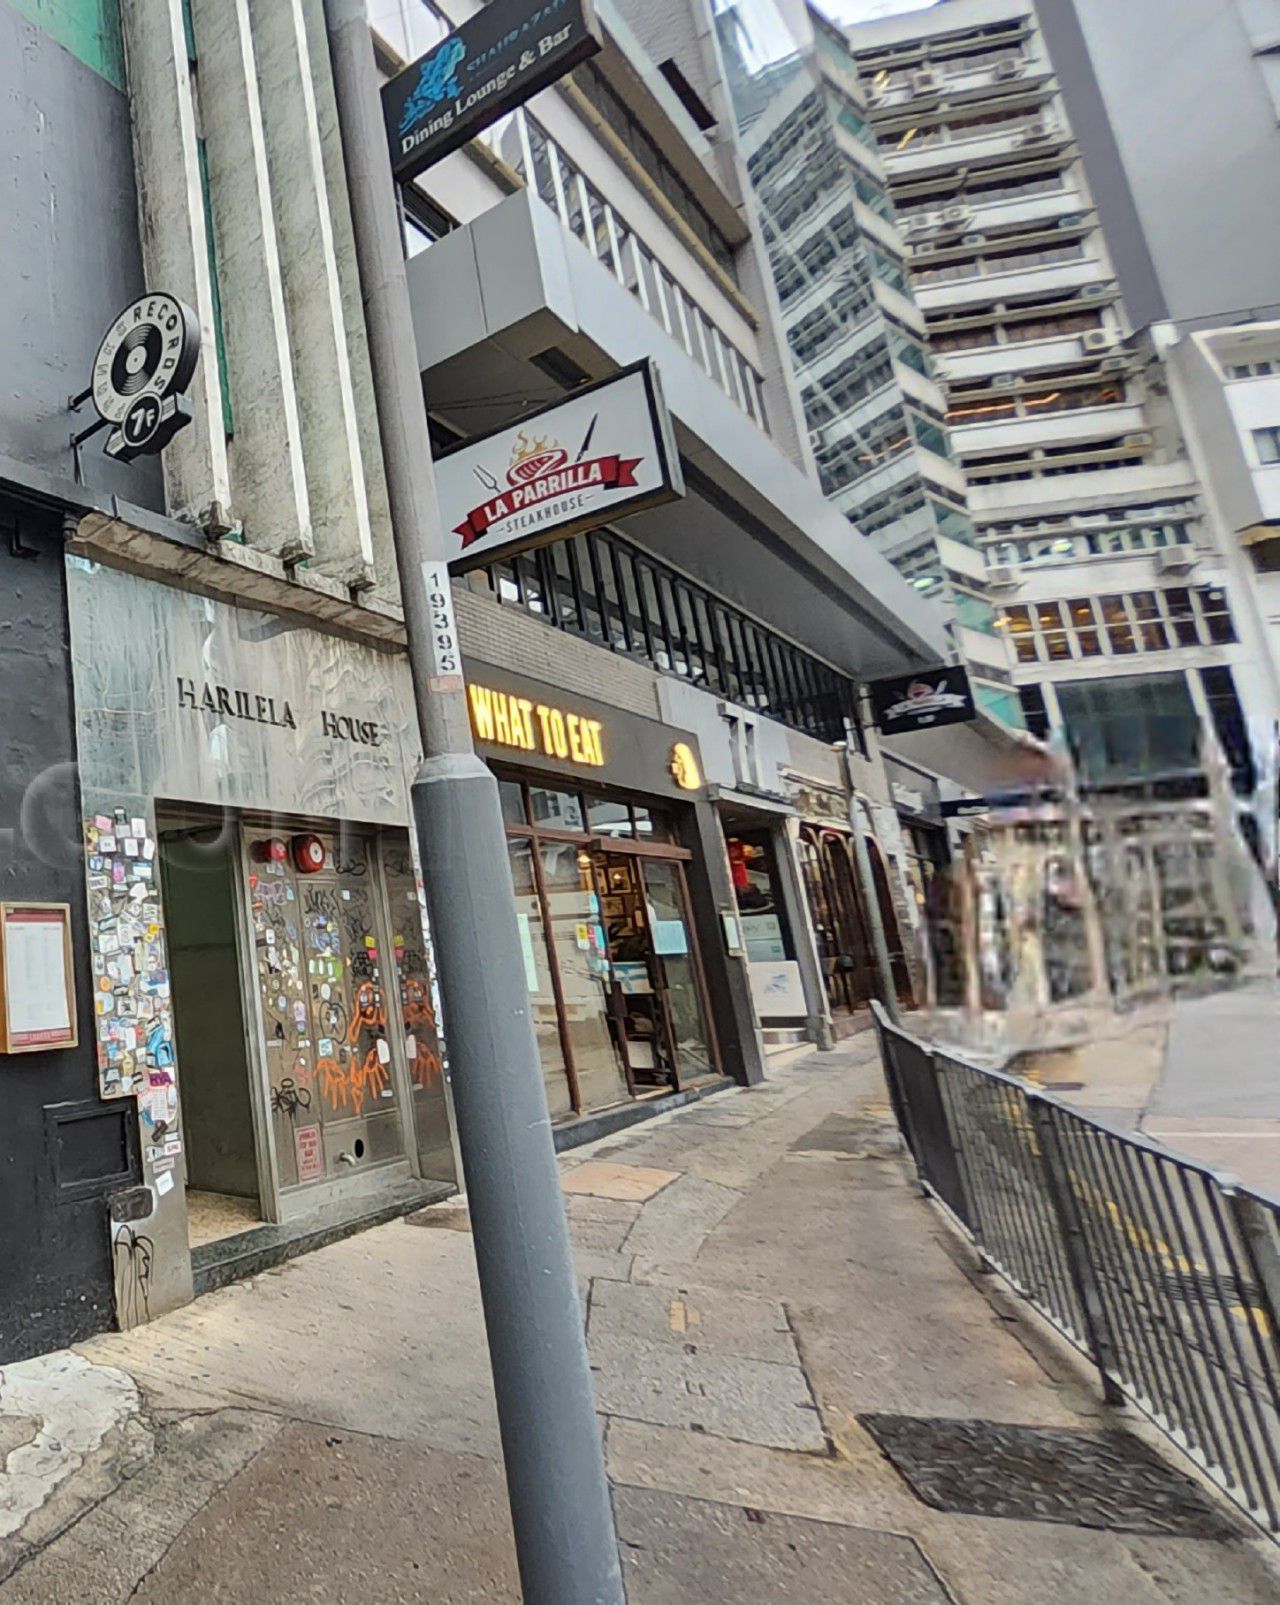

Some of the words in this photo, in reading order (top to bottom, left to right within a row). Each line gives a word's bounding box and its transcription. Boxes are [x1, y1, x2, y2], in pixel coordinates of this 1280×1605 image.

[401, 109, 455, 154] Dining
[455, 65, 516, 117] Lounge
[519, 51, 537, 71] &
[537, 24, 573, 57] Bar
[133, 300, 180, 391] RECORDS
[483, 501, 510, 522] LA
[510, 462, 603, 508] PARRILLA
[505, 495, 585, 534] STEAKHOUSE
[430, 572, 456, 671] 19395
[177, 677, 297, 730] HARILELA
[321, 710, 381, 747] HOUSE
[469, 683, 536, 750] WHAT
[536, 704, 568, 759] TO
[566, 713, 605, 767] EAT
